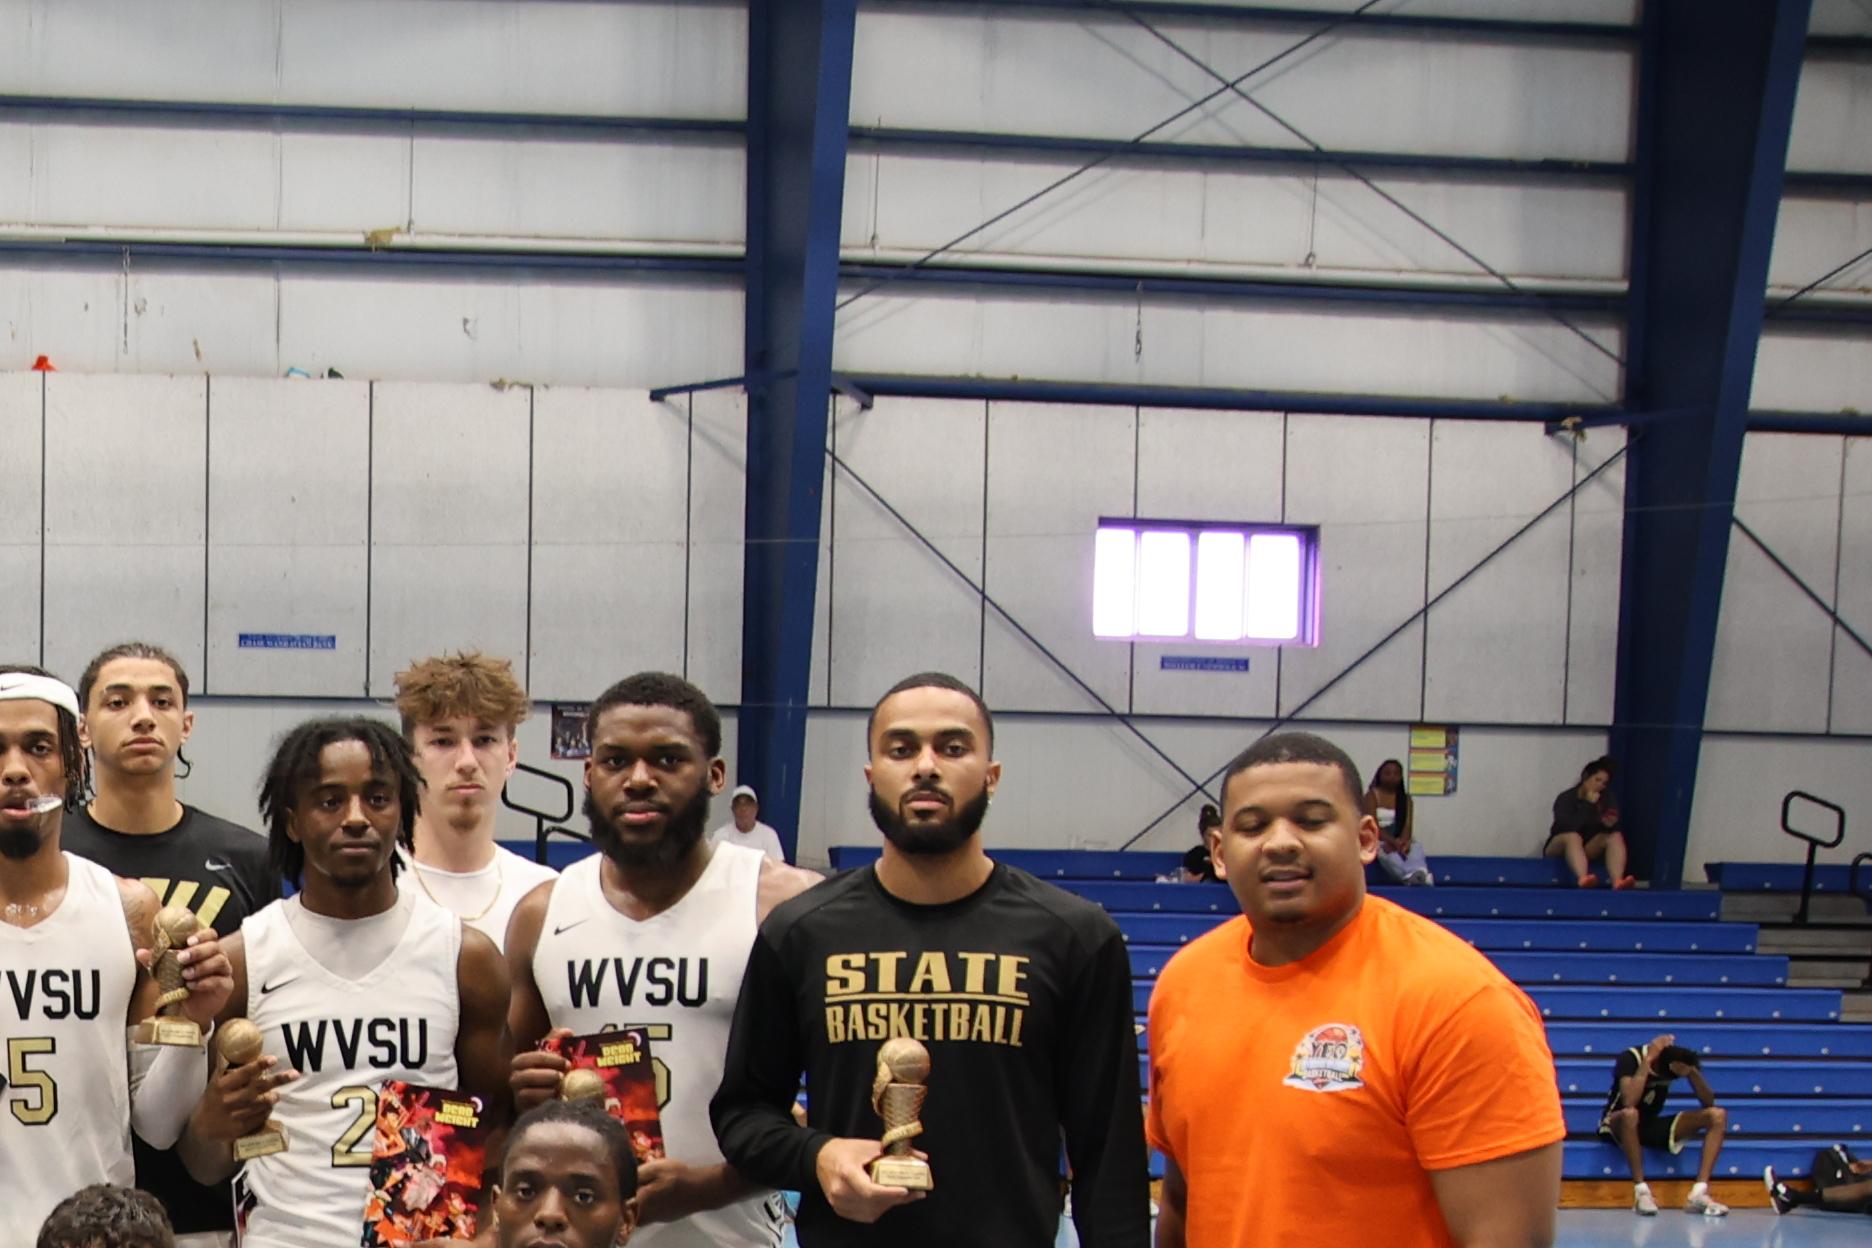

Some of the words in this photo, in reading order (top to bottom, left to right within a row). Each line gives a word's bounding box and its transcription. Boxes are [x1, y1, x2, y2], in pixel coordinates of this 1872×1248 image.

[567, 957, 708, 1009] WVSU
[826, 951, 1030, 998] STATE
[281, 1018, 428, 1073] WVSU
[825, 1003, 1023, 1047] BASKETBALL
[7, 1036, 58, 1126] 5
[331, 1085, 380, 1168] 2
